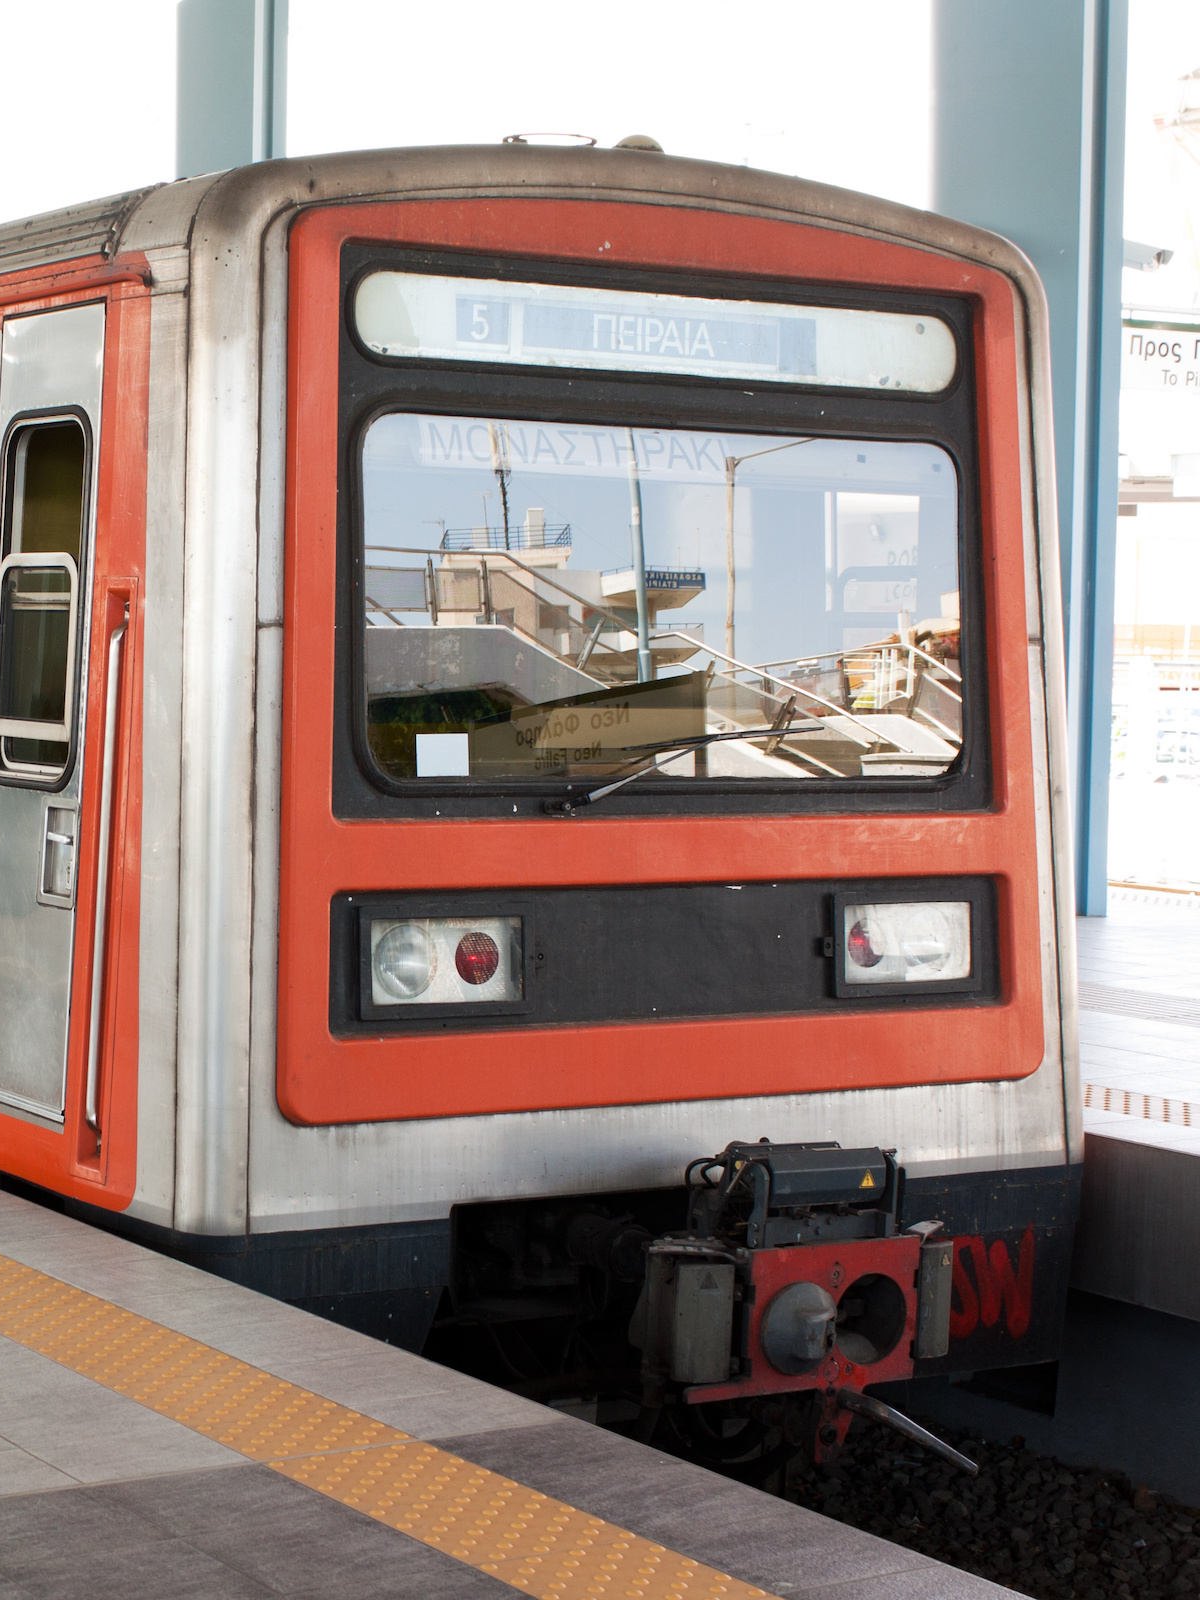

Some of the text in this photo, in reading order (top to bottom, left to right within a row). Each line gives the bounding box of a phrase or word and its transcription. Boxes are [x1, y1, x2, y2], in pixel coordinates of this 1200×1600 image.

[470, 303, 490, 341] 5
[593, 313, 715, 357] ΠΕΙΡΑΙΑ
[1129, 334, 1182, 363] Προς
[1161, 369, 1178, 386] To
